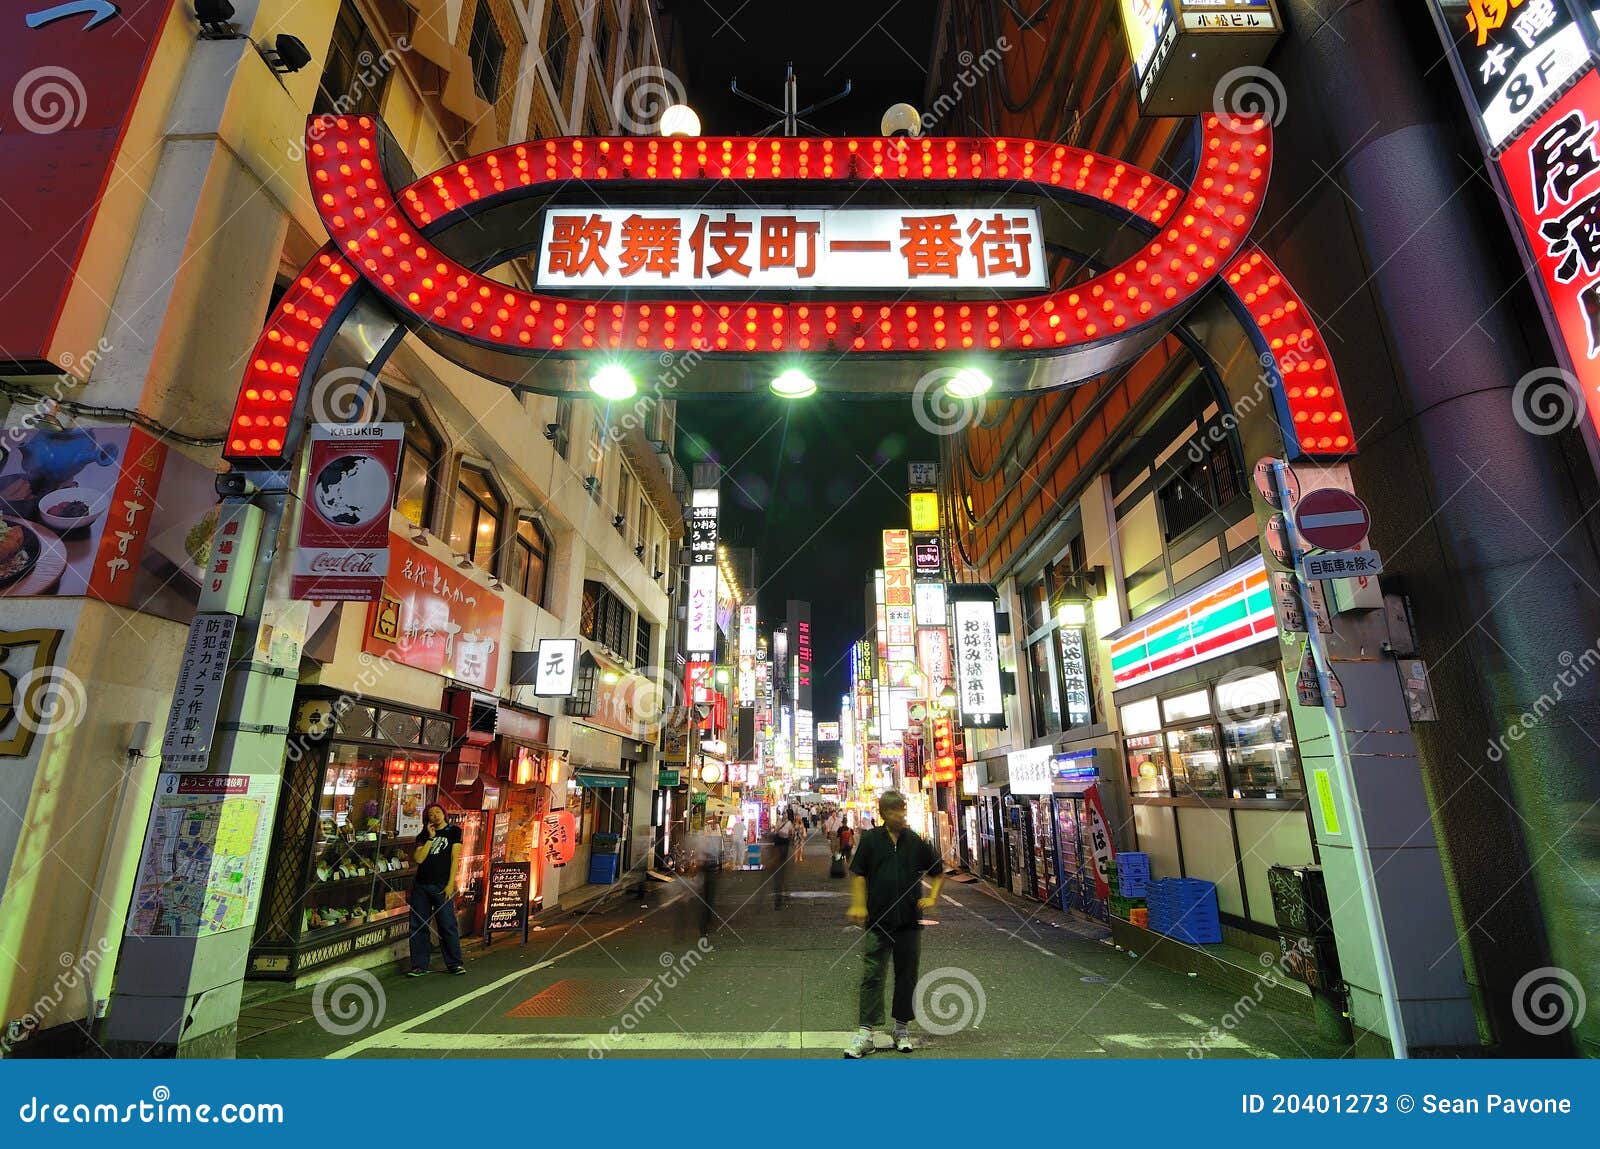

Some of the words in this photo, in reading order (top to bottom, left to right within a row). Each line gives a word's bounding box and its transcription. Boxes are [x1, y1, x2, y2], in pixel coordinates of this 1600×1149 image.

[1198, 14, 1260, 28] 小松ビル
[1505, 49, 1555, 114] 8F
[547, 211, 1034, 280] 歌舞伎町一番街
[1529, 108, 1600, 360] 居酒
[106, 500, 146, 584] すずや
[310, 551, 377, 573] Coca-Cola
[695, 554, 713, 563] 3F
[1310, 556, 1377, 575] 自転車を除く
[211, 619, 234, 681] 歌舞伎町地区
[545, 653, 566, 676] 元
[180, 619, 221, 749] 防犯カメラ作動中
[265, 958, 279, 968] 2F
